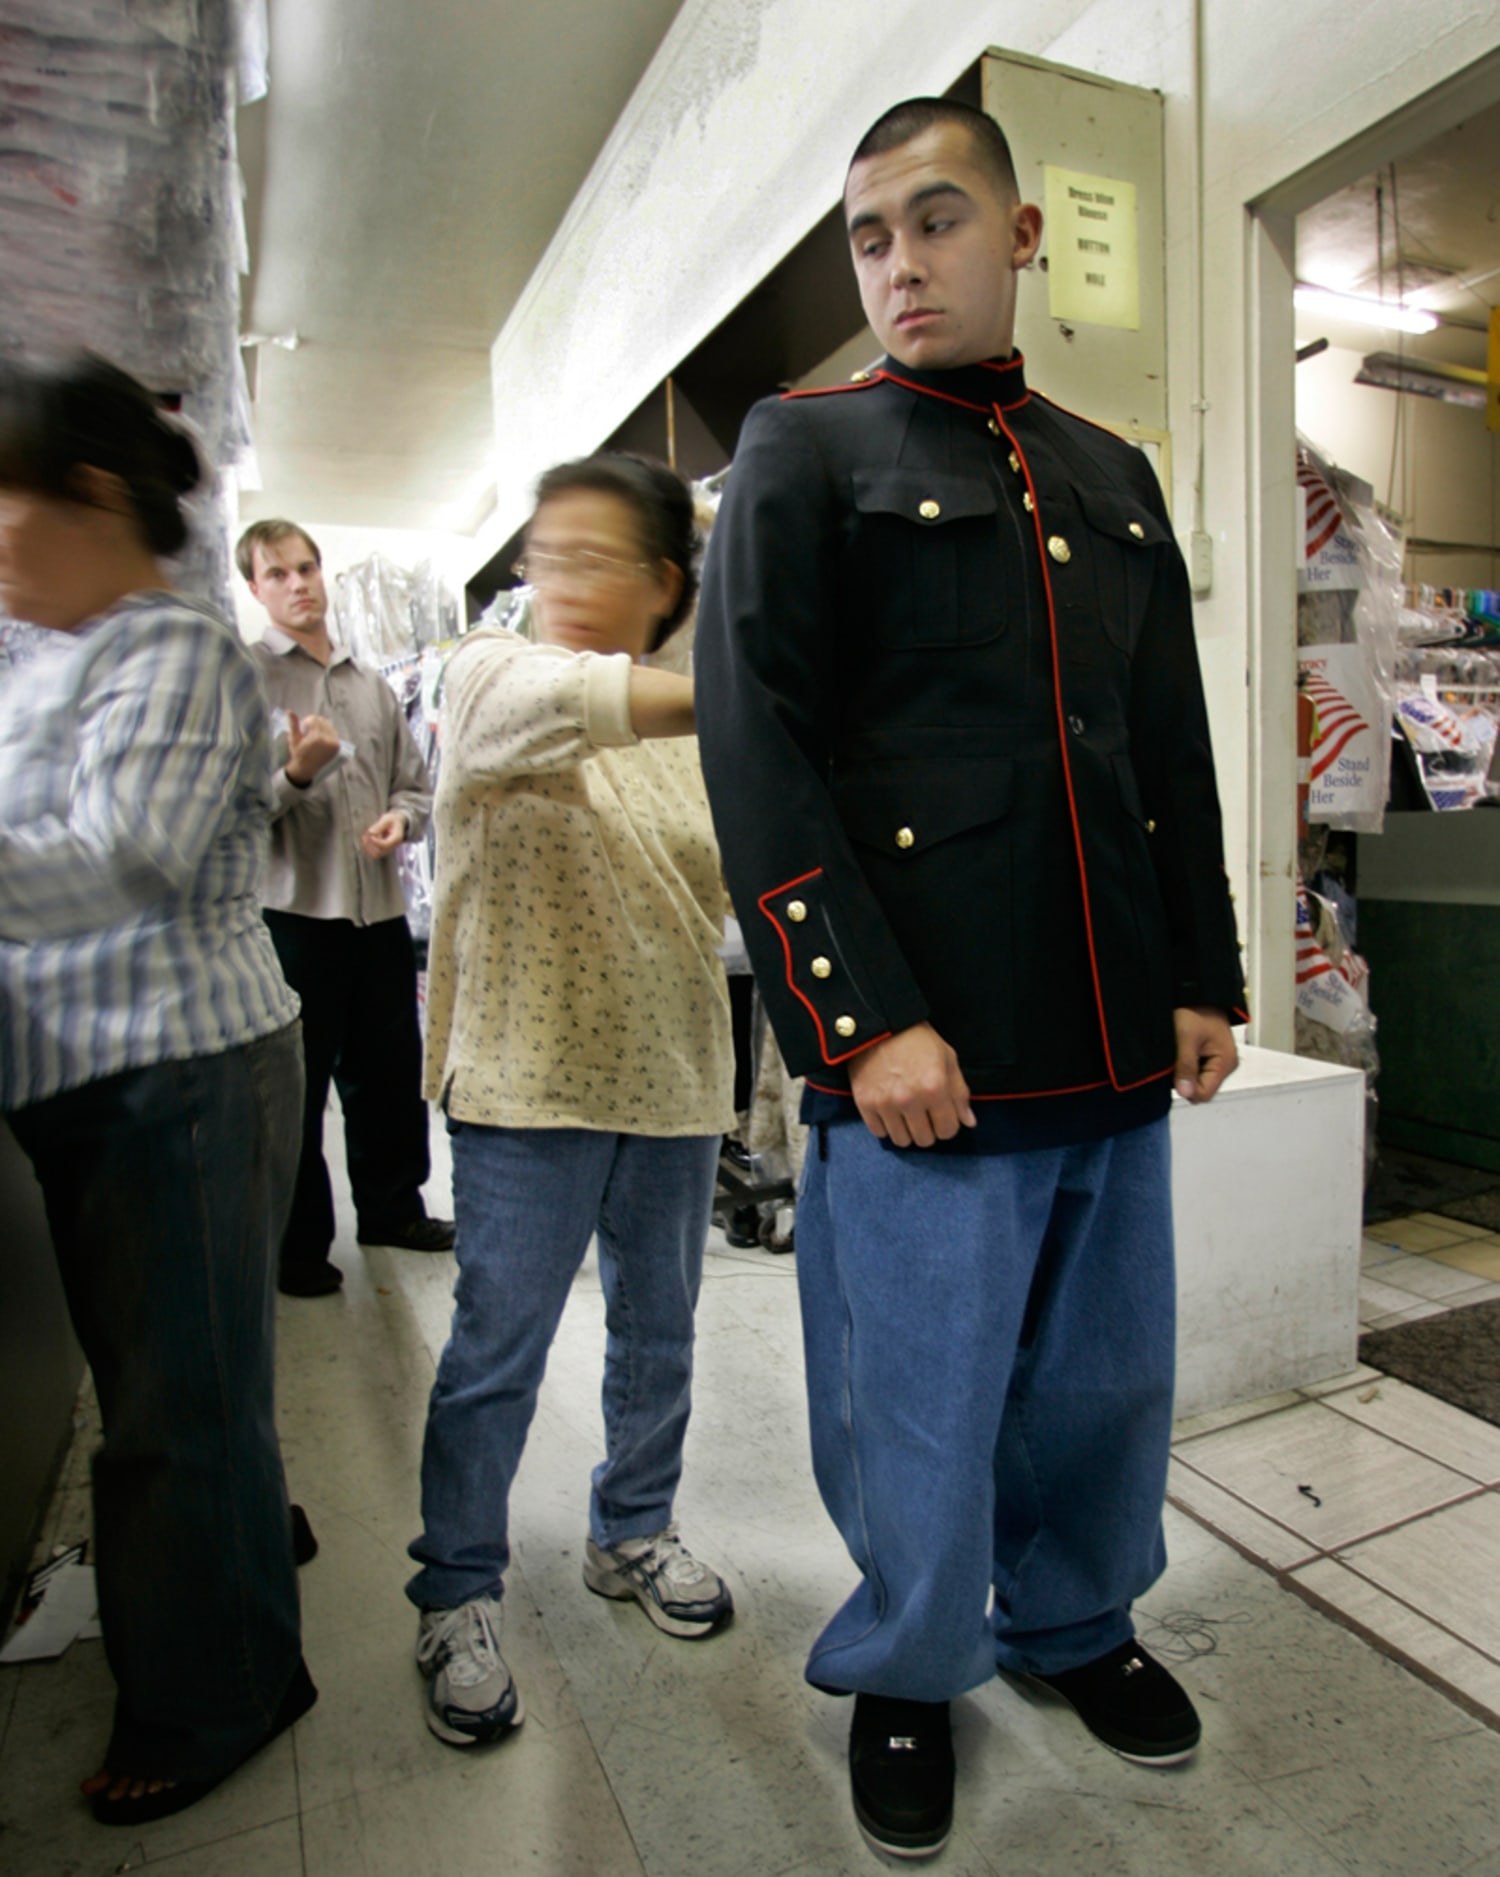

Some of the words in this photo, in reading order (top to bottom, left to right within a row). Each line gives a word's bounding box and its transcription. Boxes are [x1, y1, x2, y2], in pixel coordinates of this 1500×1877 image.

[1307, 567, 1331, 581] Her
[1338, 757, 1370, 771] Stand
[1323, 773, 1363, 788] Beside
[1311, 790, 1335, 804] Her
